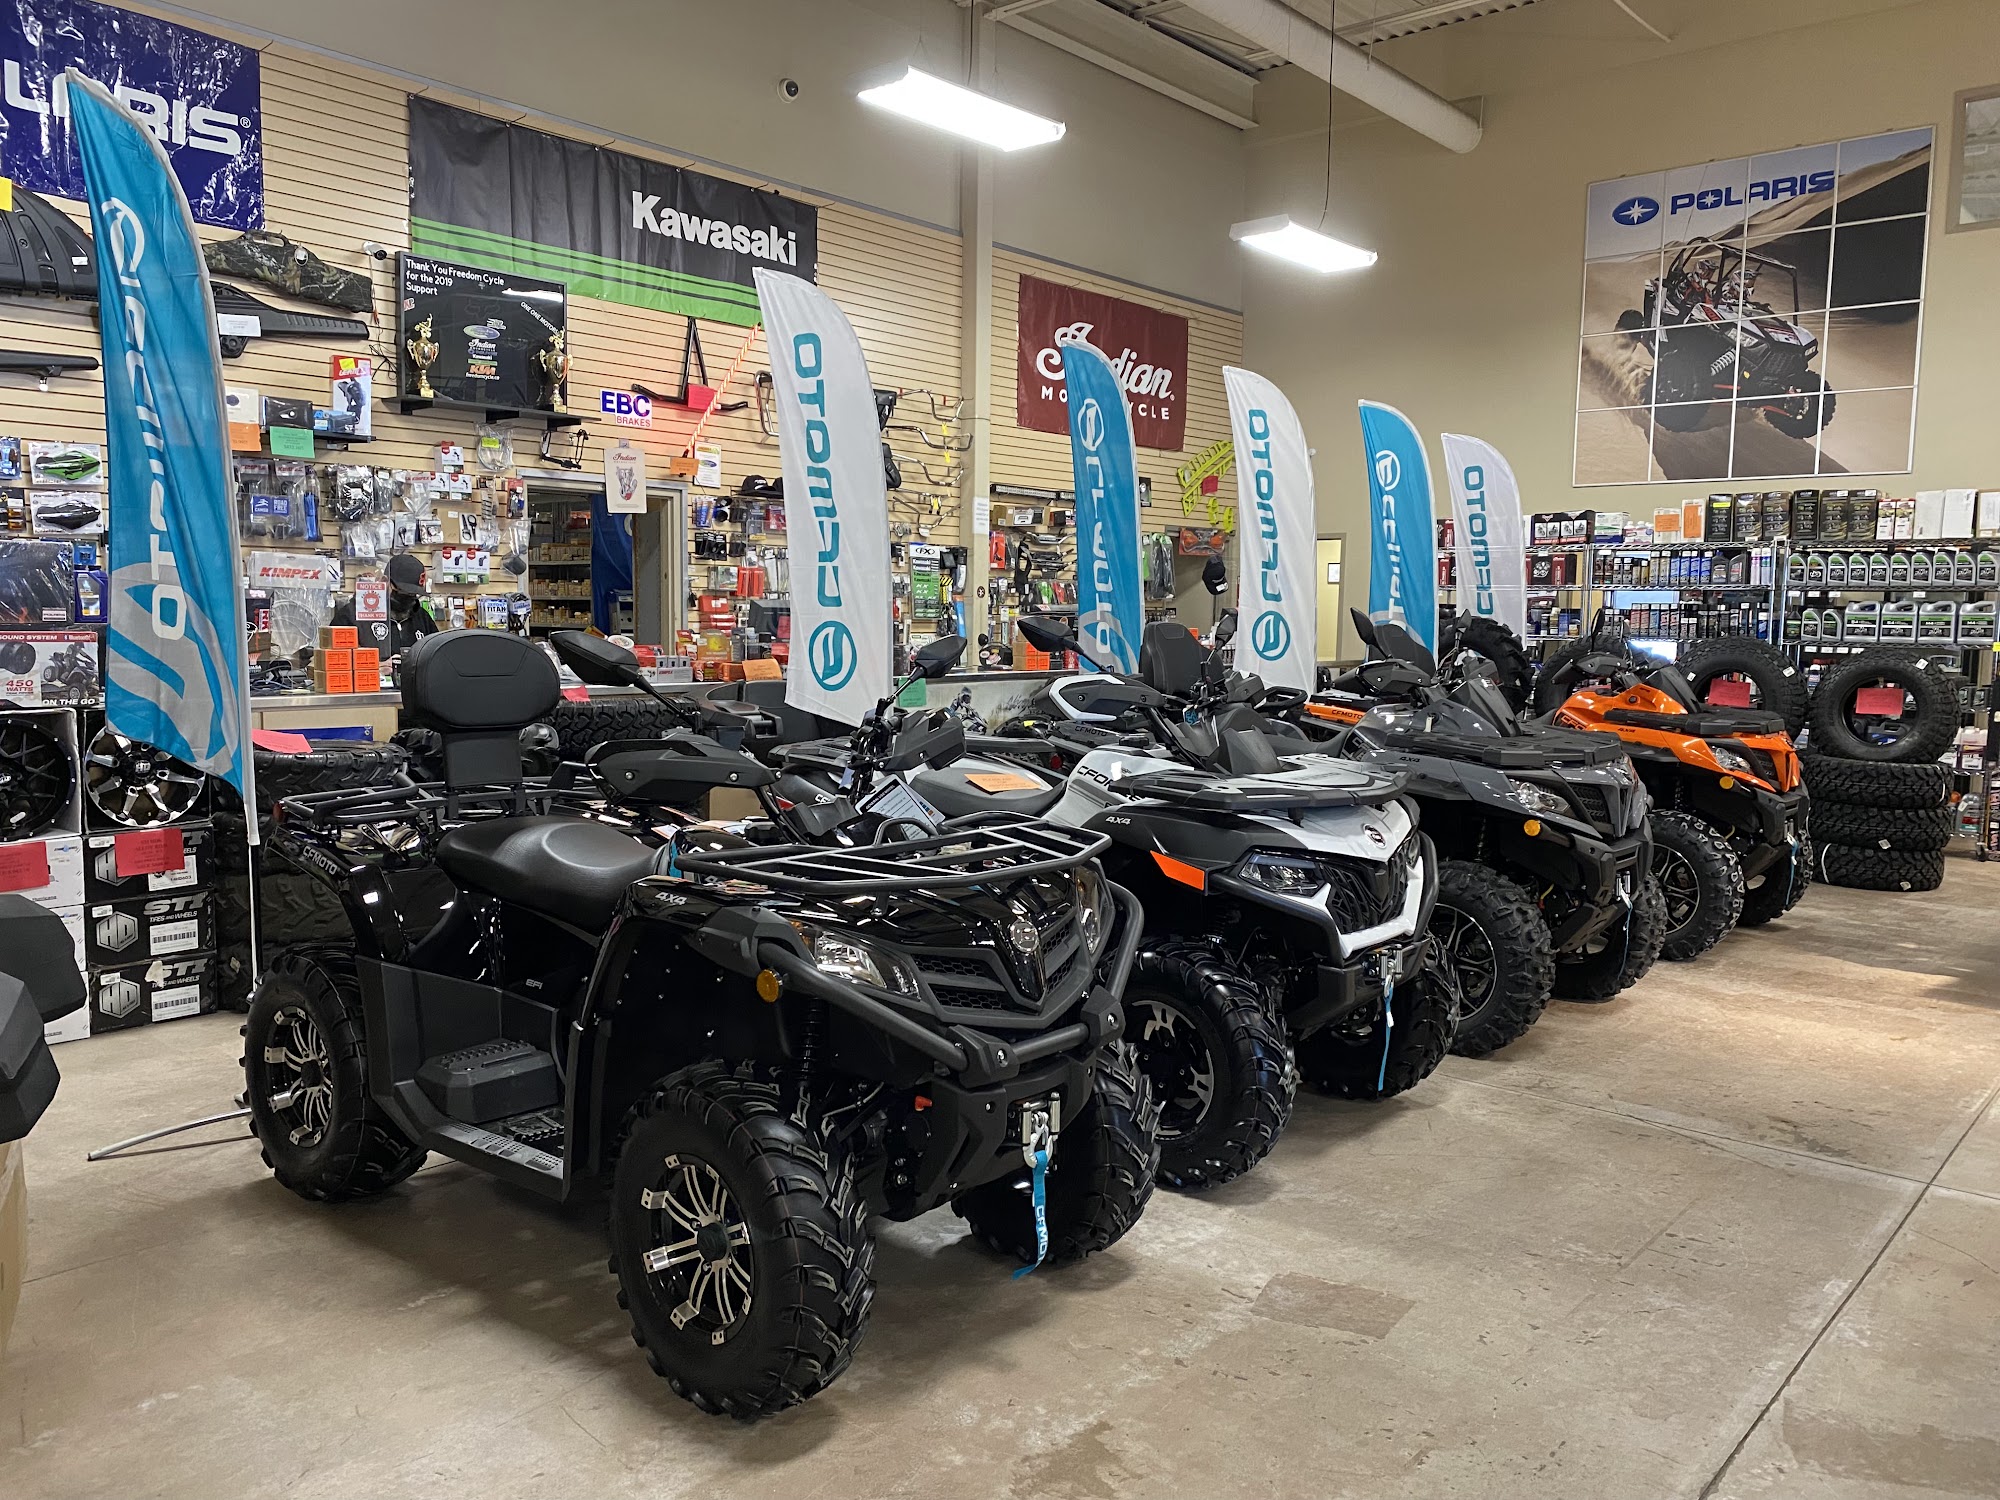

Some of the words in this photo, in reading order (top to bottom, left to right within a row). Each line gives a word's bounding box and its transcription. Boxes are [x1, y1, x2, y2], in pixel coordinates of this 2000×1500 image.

[1670, 170, 1837, 215] POLARIS
[632, 190, 797, 267] Kawasaki
[406, 259, 430, 272] Thank
[431, 264, 448, 274] You
[448, 267, 482, 282] Freedom
[483, 273, 505, 286] Cycle
[406, 271, 419, 280] for
[420, 273, 433, 283] the
[434, 276, 453, 287] 2019
[406, 282, 438, 296] Support
[601, 391, 651, 418] EBC
[616, 416, 651, 428] BRAKES
[612, 453, 637, 461] Indian
[259, 566, 322, 580] KIMPEX
[42, 698, 58, 706] ON
[1332, 709, 1364, 719] CFMOTO
[1074, 725, 1108, 737] CFMOTO
[1105, 816, 1132, 825] 4X4
[302, 845, 338, 875] CFMOTO
[144, 893, 208, 916] STI
[655, 891, 687, 906] 4X4
[150, 914, 165, 922] TIRES
[174, 910, 198, 920] WHEELS
[176, 974, 200, 985] WHEELS
[525, 978, 543, 990] EFI
